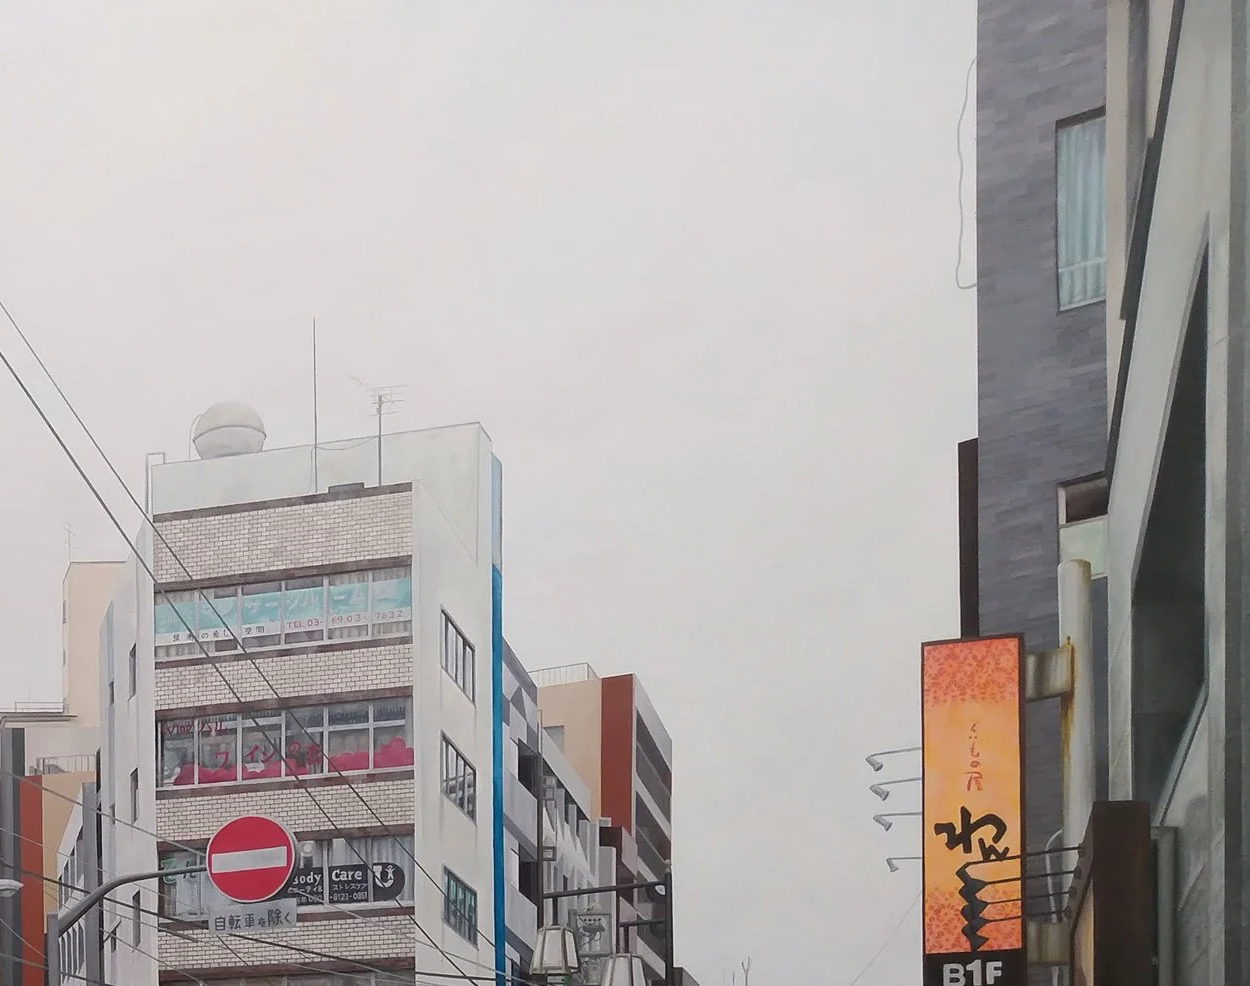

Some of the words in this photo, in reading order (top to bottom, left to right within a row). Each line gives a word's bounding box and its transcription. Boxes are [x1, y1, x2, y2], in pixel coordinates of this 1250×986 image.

[331, 868, 363, 882] Care
[214, 907, 291, 931] 自転車を除く
